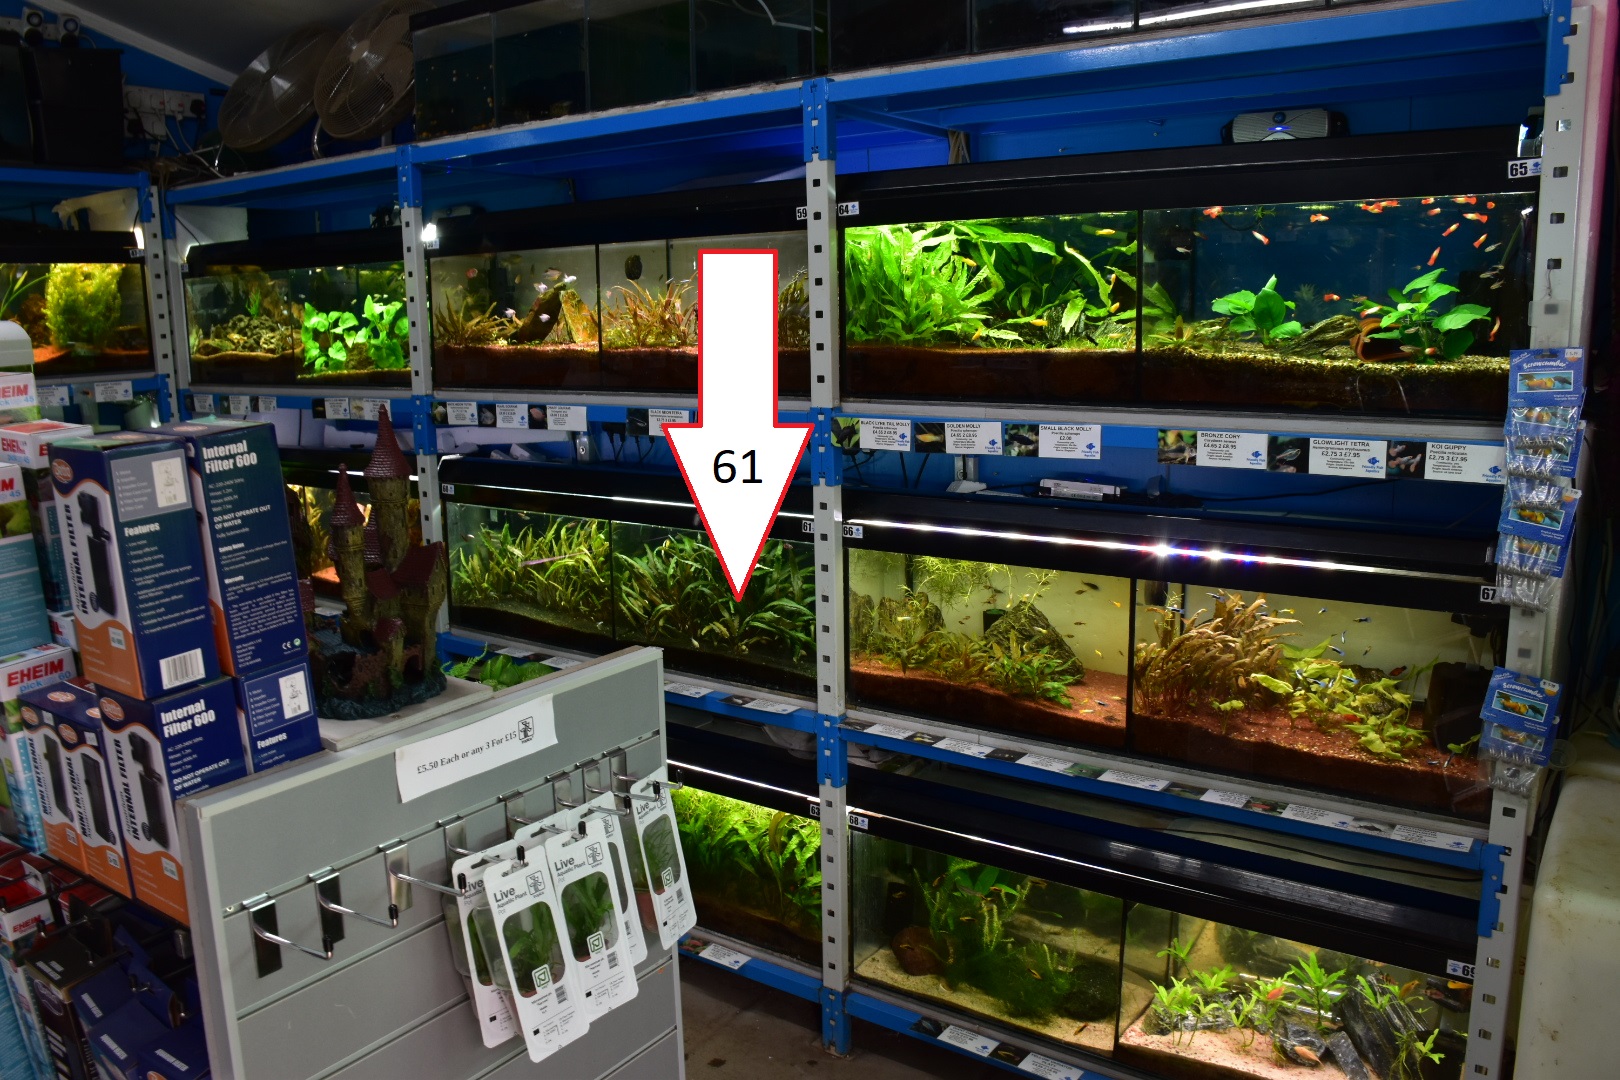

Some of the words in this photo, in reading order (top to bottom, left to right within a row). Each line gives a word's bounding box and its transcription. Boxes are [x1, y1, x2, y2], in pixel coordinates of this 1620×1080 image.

[1510, 162, 1528, 177] 65
[798, 208, 808, 219] 59
[839, 204, 850, 215] 64
[202, 440, 248, 460] Internal
[204, 458, 235, 474] Filter
[236, 452, 258, 468] 600
[10, 490, 21, 498] 45
[223, 514, 236, 522] NOT
[236, 508, 260, 518] OPERATE
[259, 504, 272, 512] OUT
[64, 504, 78, 548] FILTER
[124, 522, 160, 537] Features
[223, 519, 242, 528] WATER
[803, 522, 812, 532] 61
[844, 526, 854, 536] 66
[70, 551, 89, 616] INTERNAL
[1482, 588, 1496, 601] 67
[8, 658, 64, 688] EHEIM
[58, 671, 71, 680] 60
[160, 699, 206, 725] Internal
[163, 715, 193, 738] Filter
[194, 709, 217, 728] 600
[257, 732, 288, 750] Features
[113, 739, 129, 780] FILTER
[417, 761, 438, 775] £5.50
[440, 754, 460, 766] Each
[461, 751, 470, 759] or
[471, 747, 484, 756] any
[486, 741, 490, 750] 3
[492, 738, 504, 748] For
[505, 731, 517, 742] £15
[29, 738, 44, 788] INTERNAL
[173, 777, 183, 785] DO
[182, 772, 195, 781] NOT
[195, 763, 218, 776] OPERATE
[218, 758, 230, 767] OUT
[66, 757, 83, 809] INTERNAL
[174, 784, 183, 792] OF
[183, 776, 202, 789] WATER
[39, 790, 49, 815] MINI
[123, 782, 141, 841] INTERNAL
[636, 802, 650, 815] Live
[811, 806, 820, 816] 63
[79, 810, 88, 838] MINI
[850, 816, 859, 826] 68
[554, 857, 575, 872] Live
[557, 866, 574, 878] Aquatic
[574, 861, 586, 870] Plant
[464, 889, 483, 900] Aquatic
[493, 887, 516, 905] Live
[497, 896, 515, 909] Aquatic
[515, 891, 528, 902] Plant
